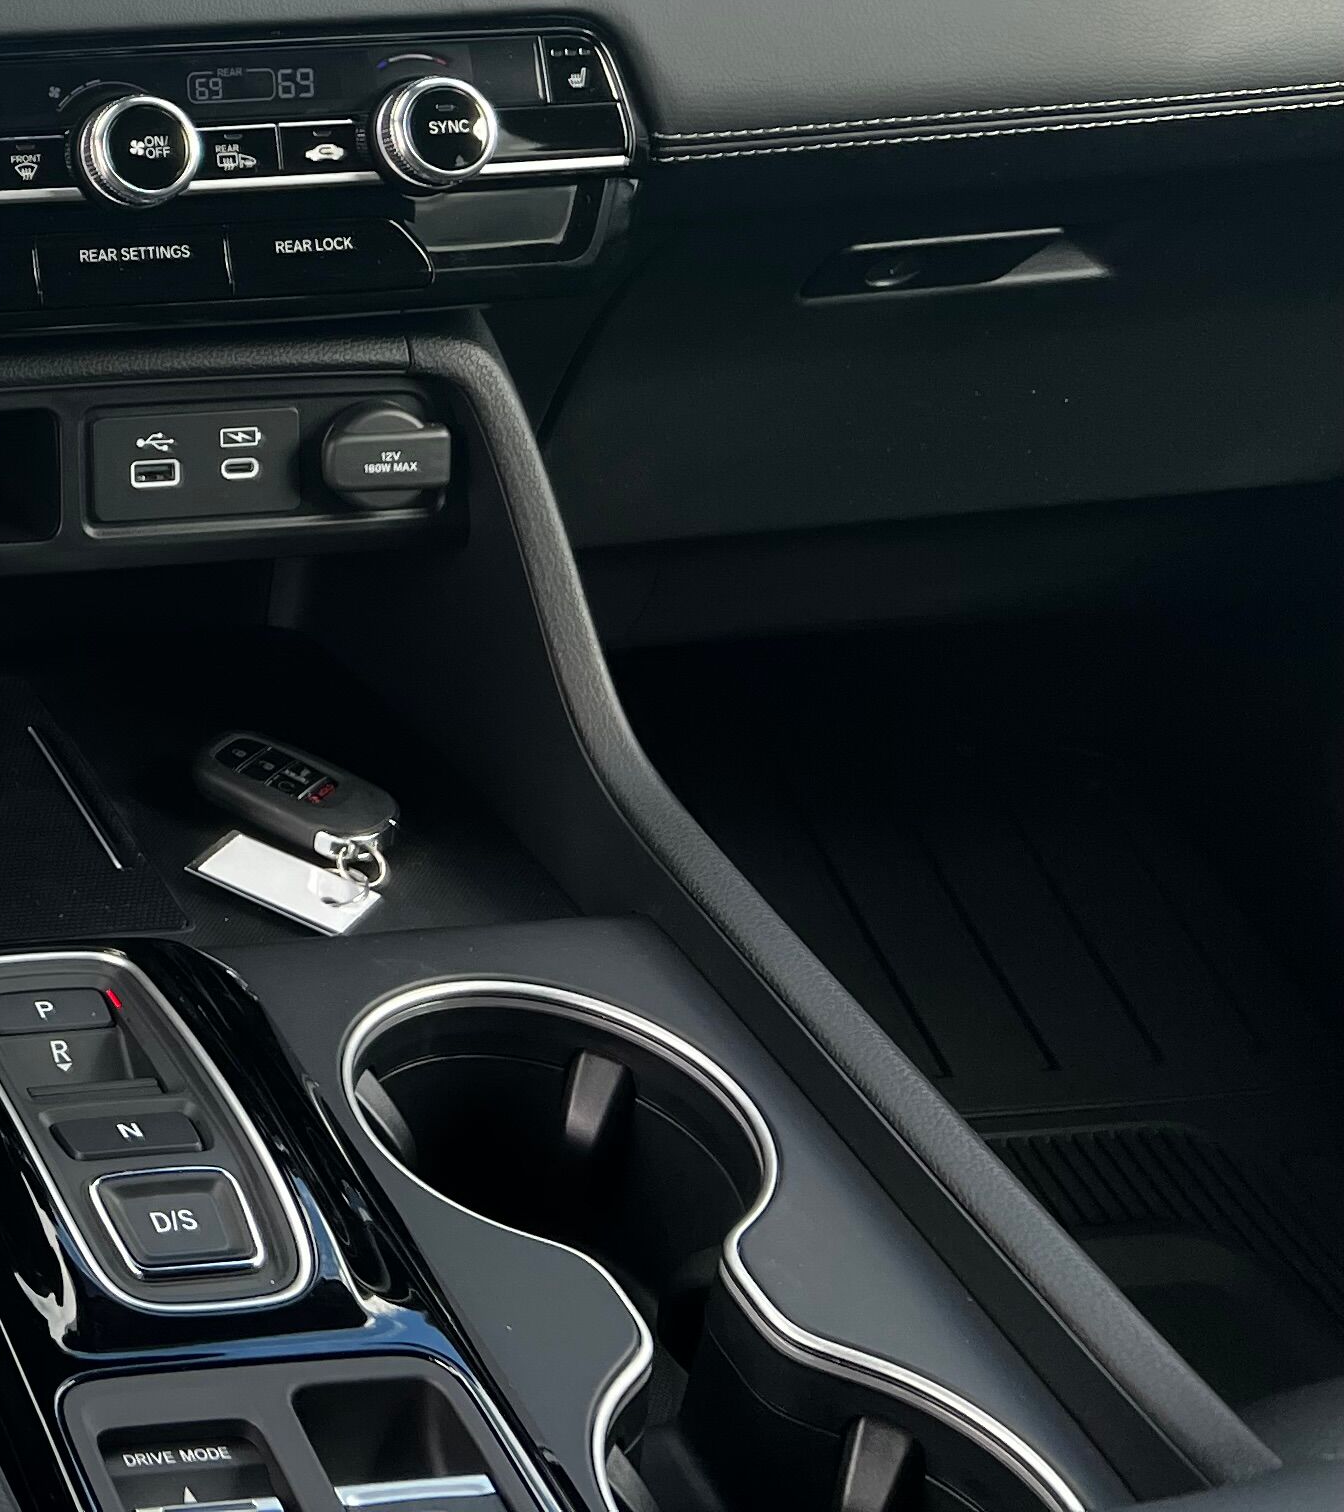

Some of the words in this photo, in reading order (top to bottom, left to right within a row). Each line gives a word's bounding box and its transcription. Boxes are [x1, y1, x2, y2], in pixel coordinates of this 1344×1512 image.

[217, 68, 242, 77] REAR
[195, 78, 223, 100] 69
[278, 68, 314, 99] 69
[428, 119, 470, 135] SYNC
[145, 147, 171, 160] OFF
[215, 144, 240, 153] REAR
[10, 154, 42, 164] FRONT
[79, 249, 118, 263] REAR
[121, 244, 191, 261] SETTINGS
[275, 240, 312, 254] REAR
[314, 236, 353, 251] LOCK
[381, 451, 401, 461] 12V
[393, 461, 418, 472] MAX
[35, 1001, 53, 1018] P
[50, 1040, 69, 1063] R
[117, 1122, 145, 1140] N
[150, 1209, 198, 1233] D/S
[122, 1451, 177, 1467] DRIVE
[179, 1446, 232, 1462] MODE
